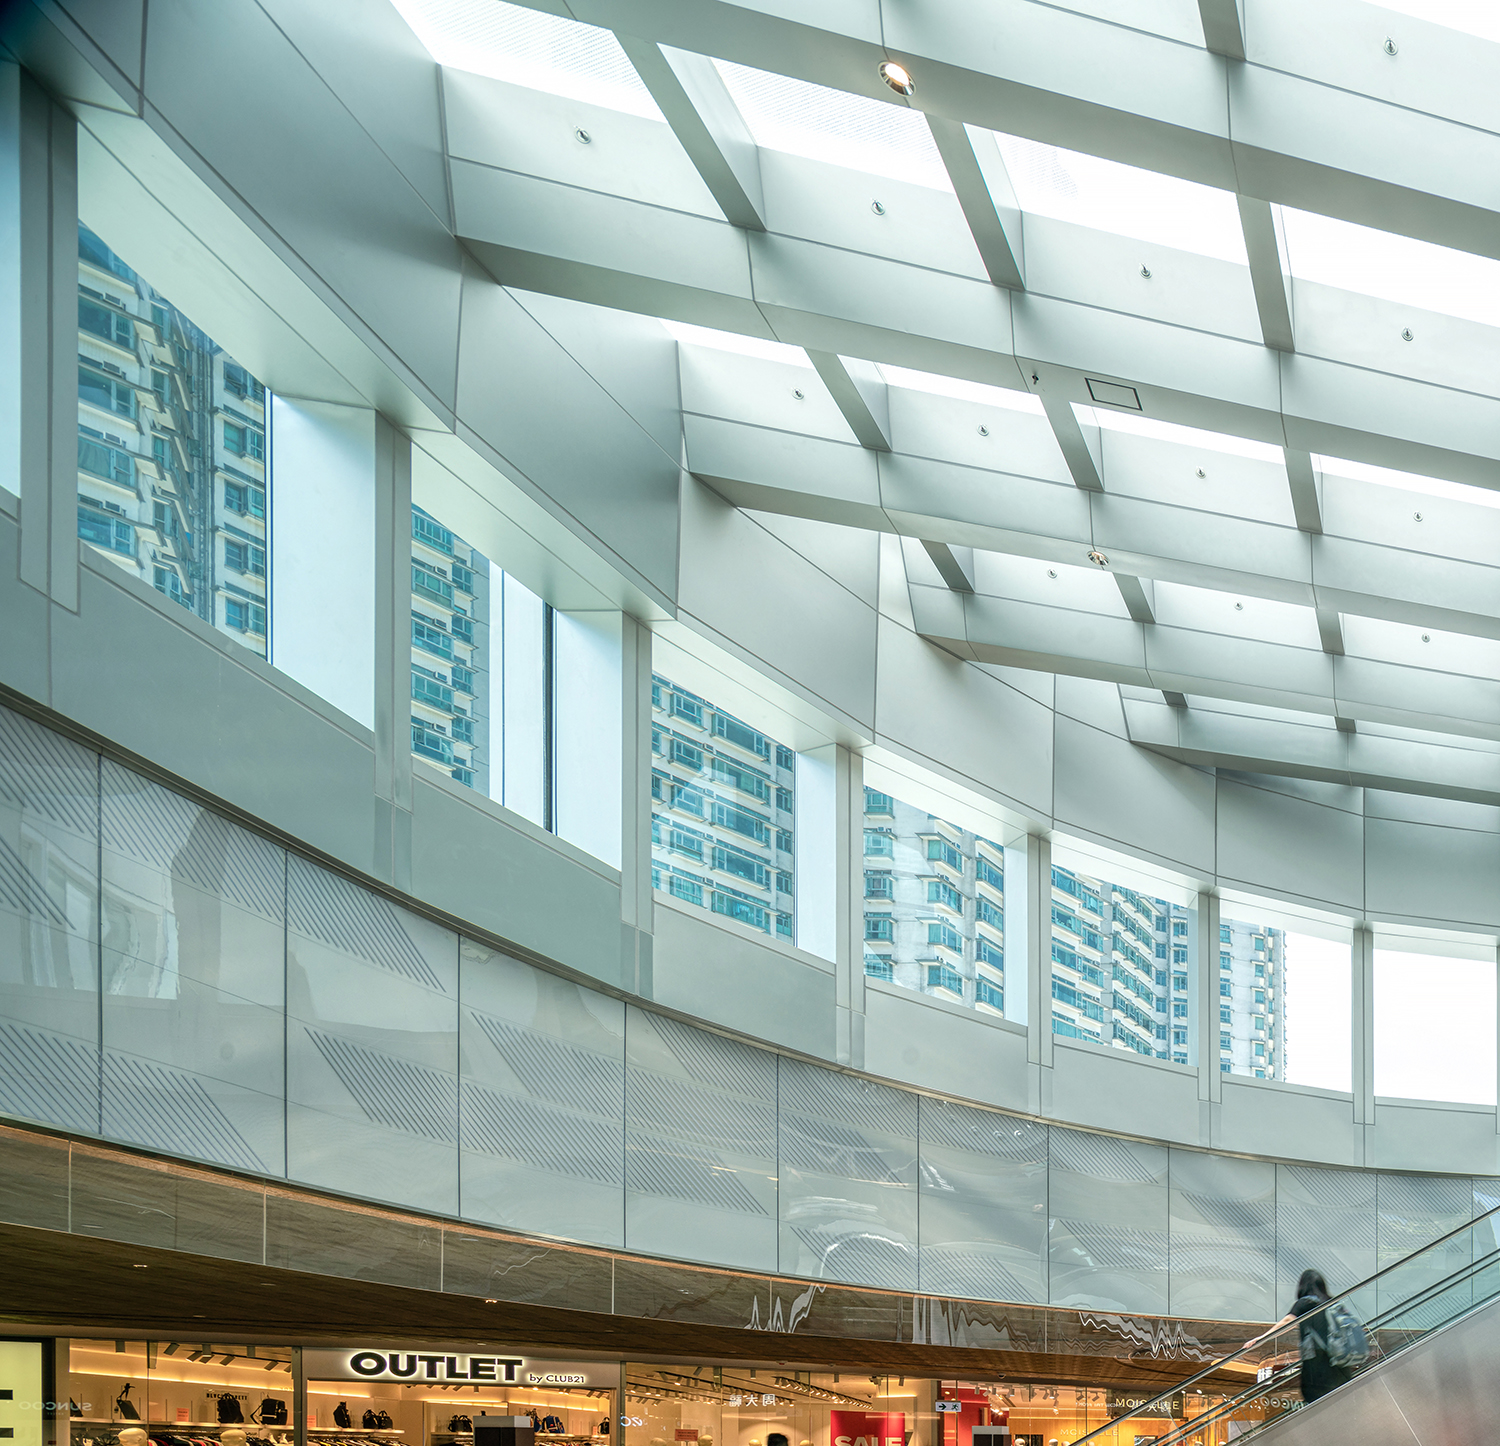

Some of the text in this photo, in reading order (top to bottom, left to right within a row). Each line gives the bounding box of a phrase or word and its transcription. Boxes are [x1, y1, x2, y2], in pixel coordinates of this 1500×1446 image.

[350, 1352, 585, 1383] OUTLET by CLUB21
[1116, 1399, 1180, 1410] MOISLLE
